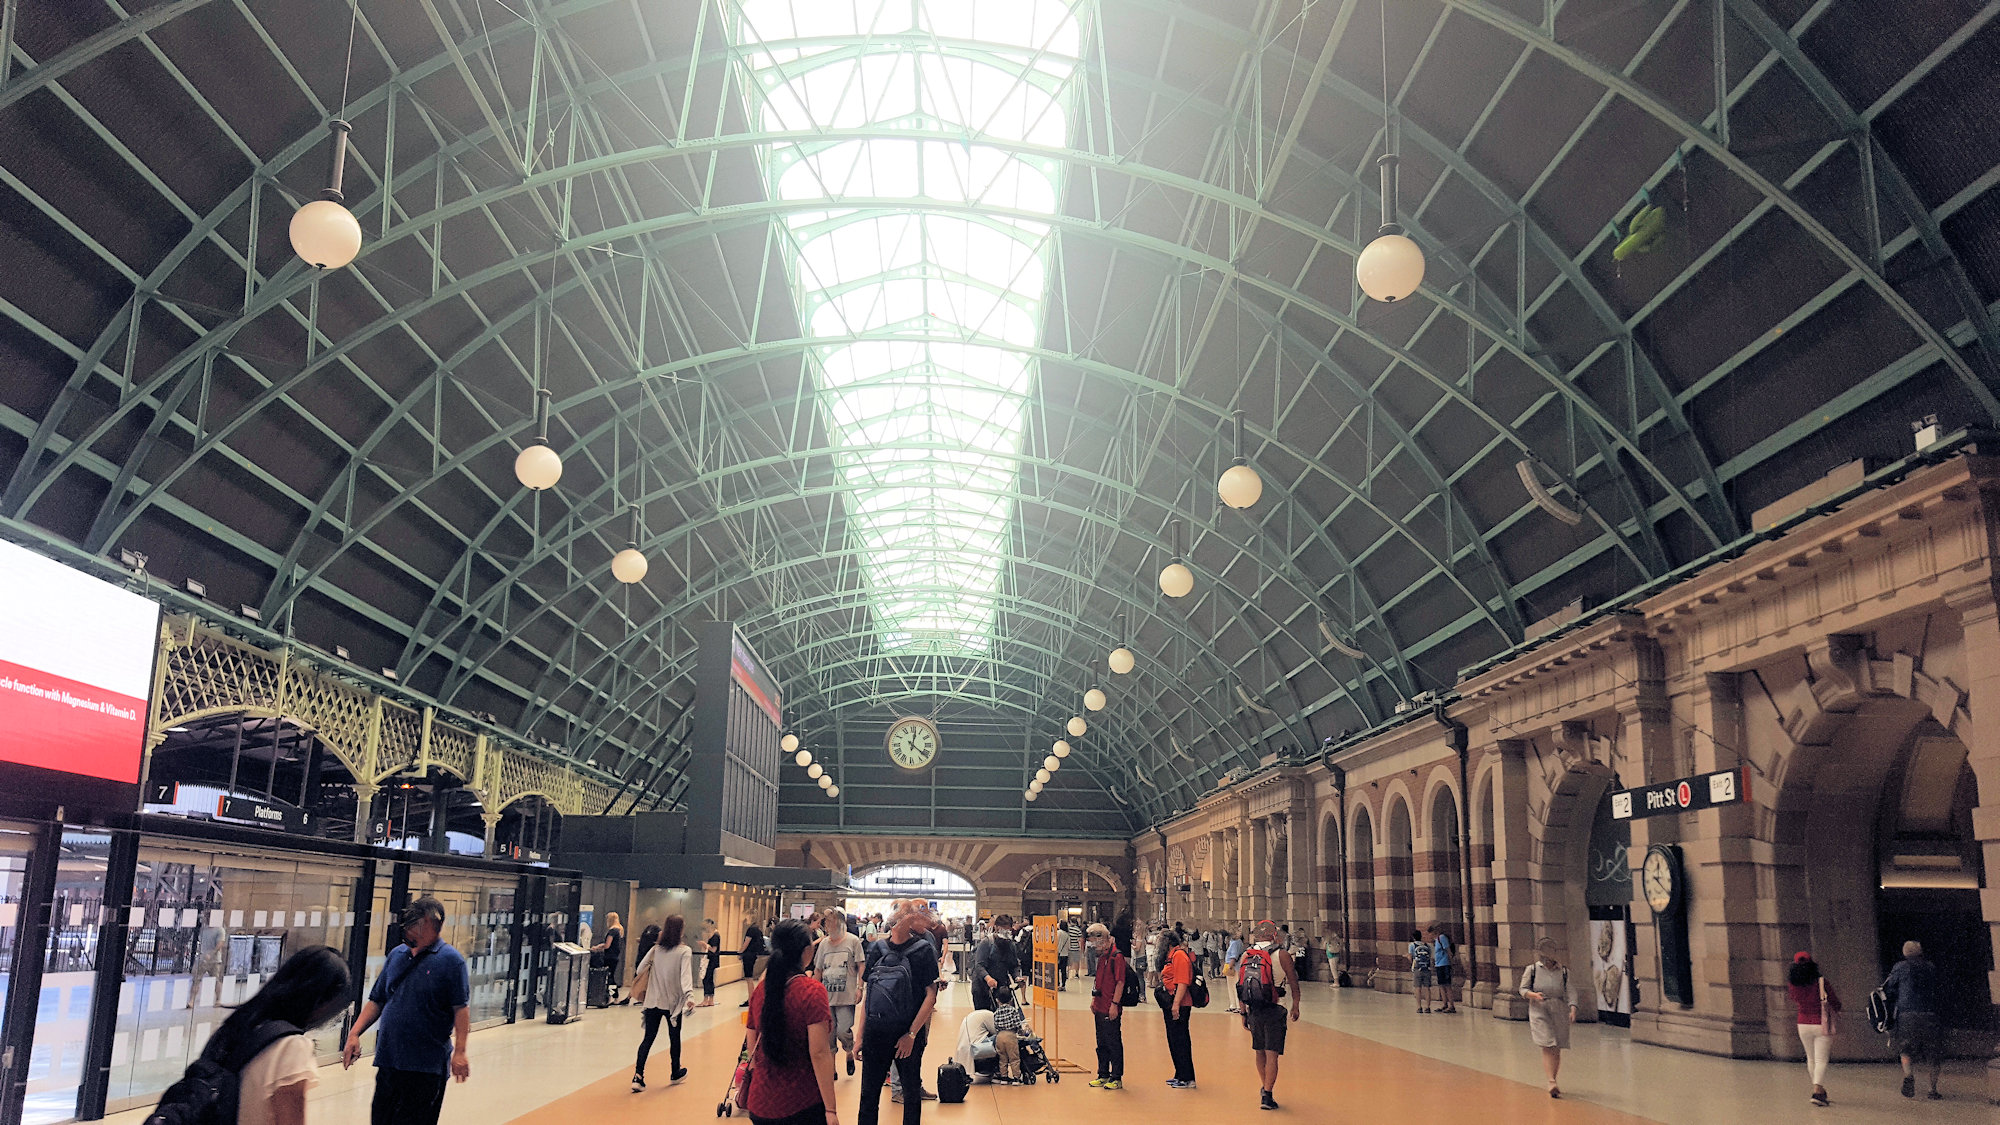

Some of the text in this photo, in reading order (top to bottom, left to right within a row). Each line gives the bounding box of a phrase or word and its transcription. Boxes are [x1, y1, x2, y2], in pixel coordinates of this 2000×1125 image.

[0, 676, 12, 689] cle
[13, 679, 44, 697] function
[45, 689, 61, 702] with
[61, 691, 99, 712] Magnesium
[100, 702, 105, 713] &
[105, 703, 129, 719] Vitamin
[158, 786, 168, 800] 7
[1724, 777, 1731, 796] 2
[1624, 797, 1629, 813] 2
[1647, 791, 1664, 809] Pitt
[1665, 788, 1676, 807] St
[225, 800, 309, 825] 7 Platforms 6
[375, 822, 383, 834] 6
[500, 844, 507, 853] 5
